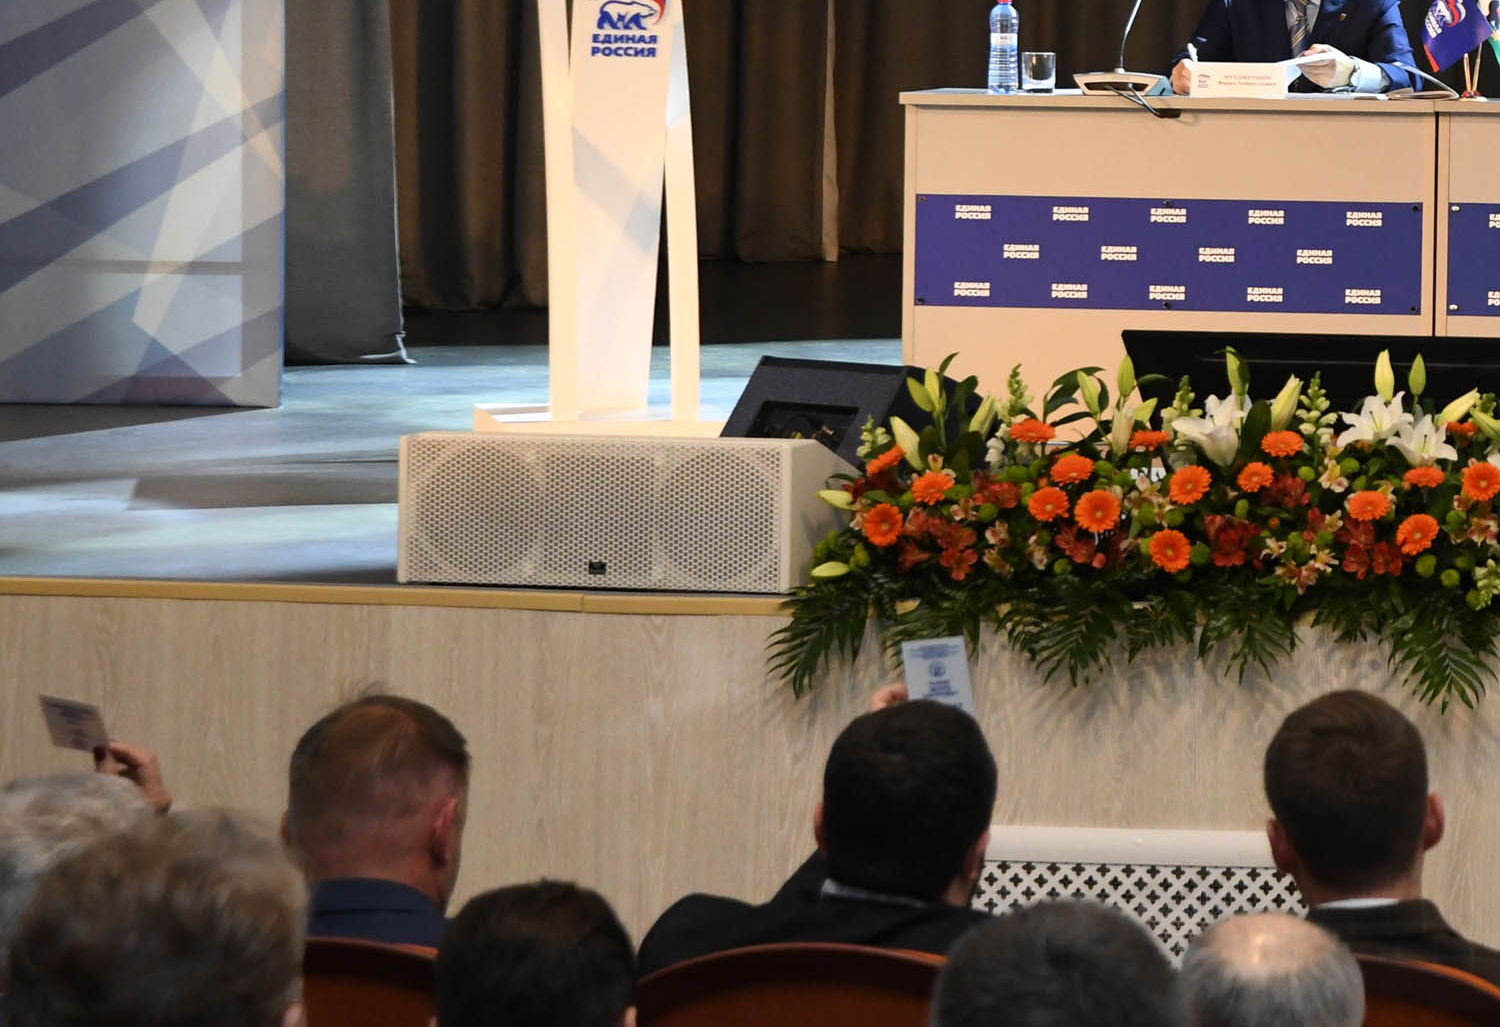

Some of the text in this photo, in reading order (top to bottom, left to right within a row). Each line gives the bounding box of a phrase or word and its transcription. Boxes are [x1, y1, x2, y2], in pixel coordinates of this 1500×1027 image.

[591, 34, 657, 45] ЕДИНАЯ
[591, 46, 656, 58] РОССИЯ
[955, 204, 992, 212] ЕДИНАЯ
[1053, 206, 1090, 214] ЕДИНАЯ
[1151, 207, 1187, 216] ЕДИНАЯ
[955, 211, 992, 220] РОССИЯ
[1053, 213, 1090, 222] РОССИЯ
[1249, 209, 1285, 218] ЕДИНАЯ
[1347, 211, 1383, 219] ЕДИНАЯ
[1150, 215, 1187, 224] РОССИЯ
[1248, 217, 1285, 225] РОССИЯ
[1346, 218, 1383, 227] РОССИЯ
[1004, 243, 1040, 252] ЕДИНАЯ
[1101, 245, 1138, 254] ЕДИНАЯ
[1199, 247, 1235, 255] ЕДИНАЯ
[1003, 251, 1040, 260] РОССИЯ
[1101, 253, 1138, 261] РОССИЯ
[1297, 249, 1333, 257] ЕДИНАЯ
[1199, 254, 1235, 263] РОССИЯ
[1297, 256, 1333, 265] РОССИЯ
[954, 281, 991, 290] ЕДИНАЯ
[1052, 283, 1089, 291] ЕДИНАЯ
[1149, 284, 1186, 293] ЕДИНАЯ
[954, 289, 991, 297] РОССИЯ
[1052, 290, 1088, 299] РОССИЯ
[1247, 286, 1284, 295] ЕДИНАЯ
[1345, 288, 1382, 297] ЕДИНАЯ
[1149, 292, 1186, 301] РОССИЯ
[1247, 294, 1284, 303] РОССИЯ
[1345, 296, 1382, 305] РОССИЯ
